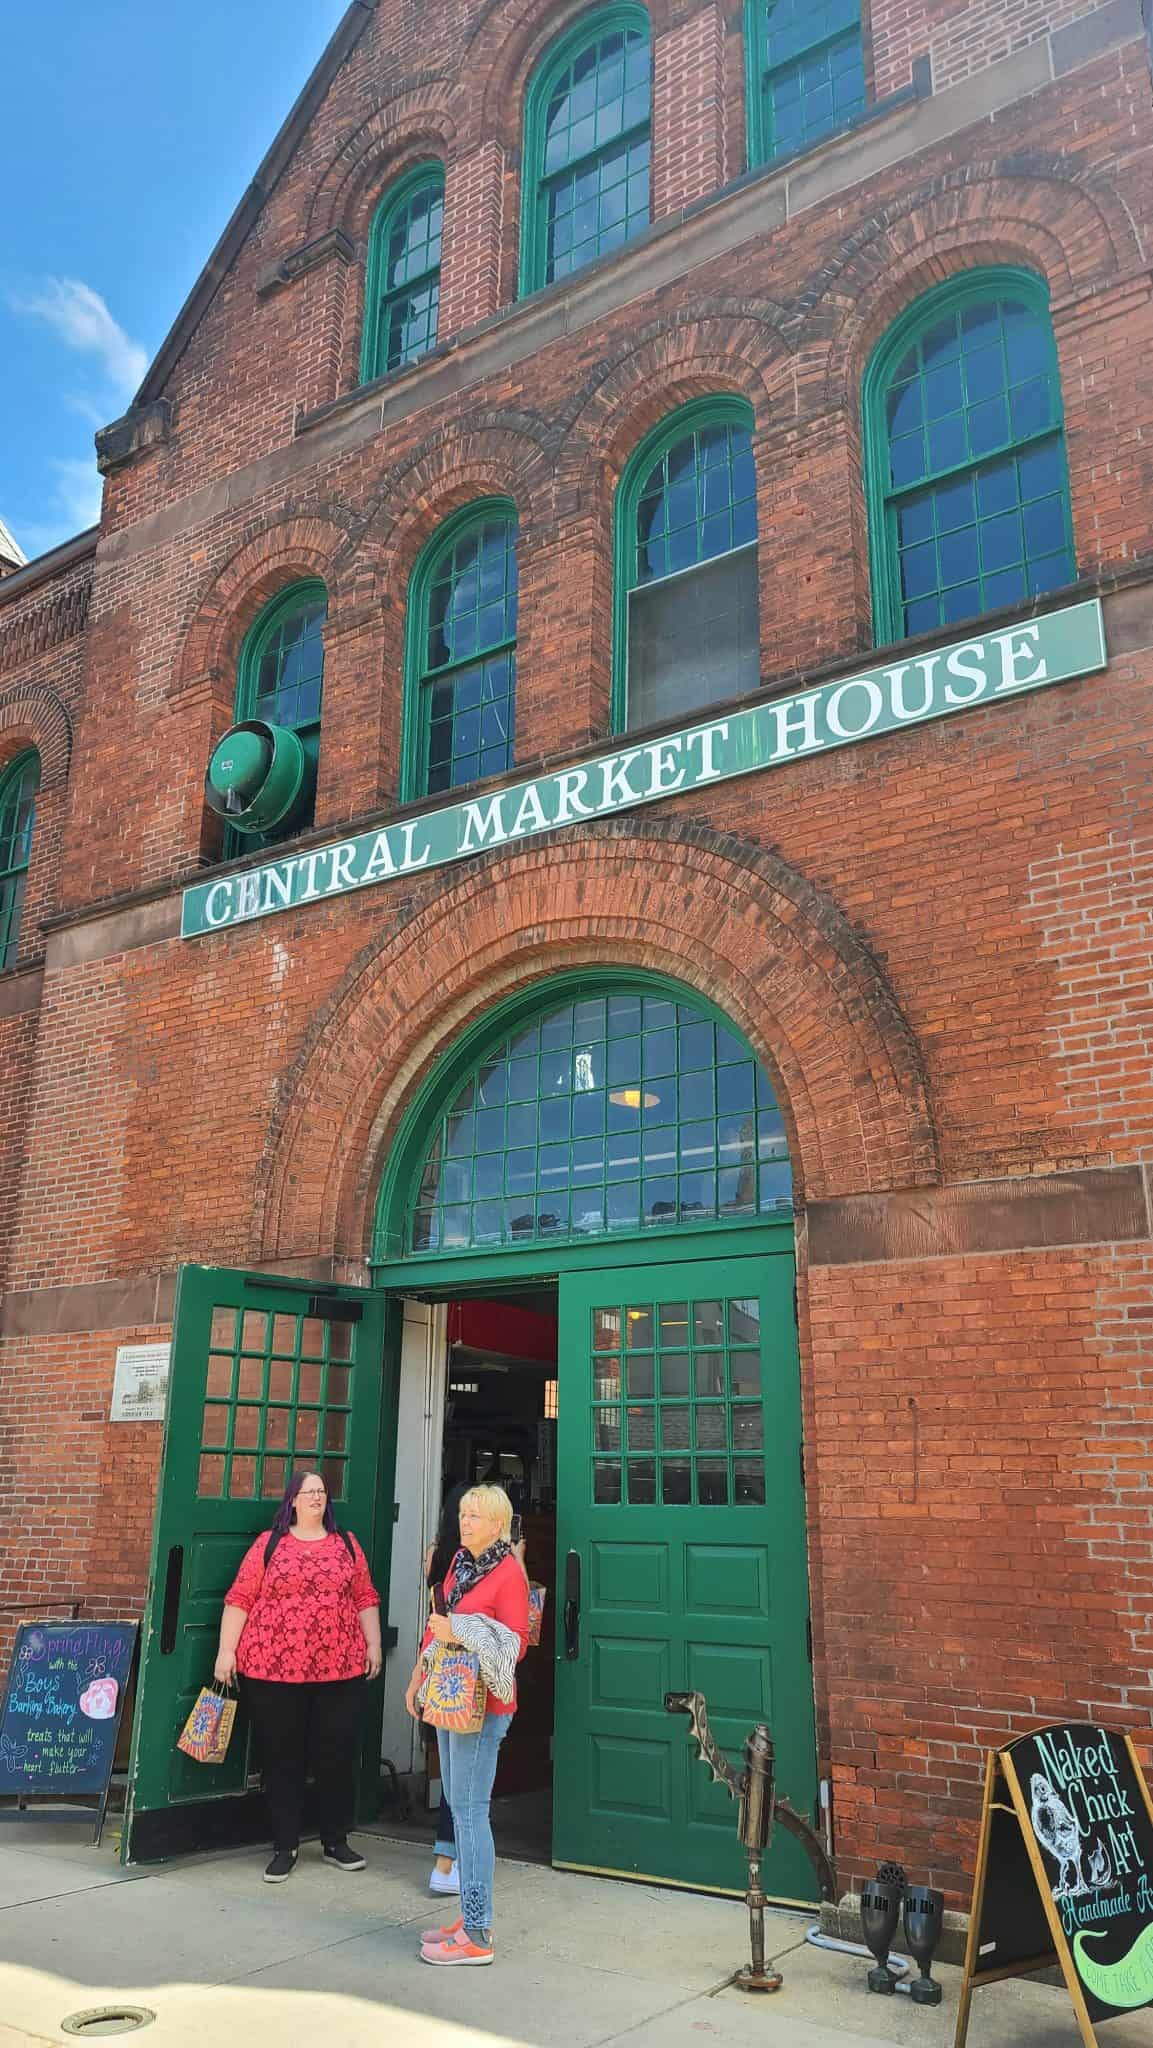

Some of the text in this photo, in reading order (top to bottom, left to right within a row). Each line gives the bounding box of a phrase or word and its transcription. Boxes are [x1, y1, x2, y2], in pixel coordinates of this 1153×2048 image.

[205, 624, 1047, 925] CENTRAL MARKET HOUSE
[27, 1728, 93, 1744] treats that will
[42, 1745, 87, 1763] make your
[1033, 1729, 1119, 1796] Naked
[1068, 1775, 1135, 1837] Chick
[1108, 1821, 1144, 1875] Art
[1061, 1881, 1132, 1937] Handmade
